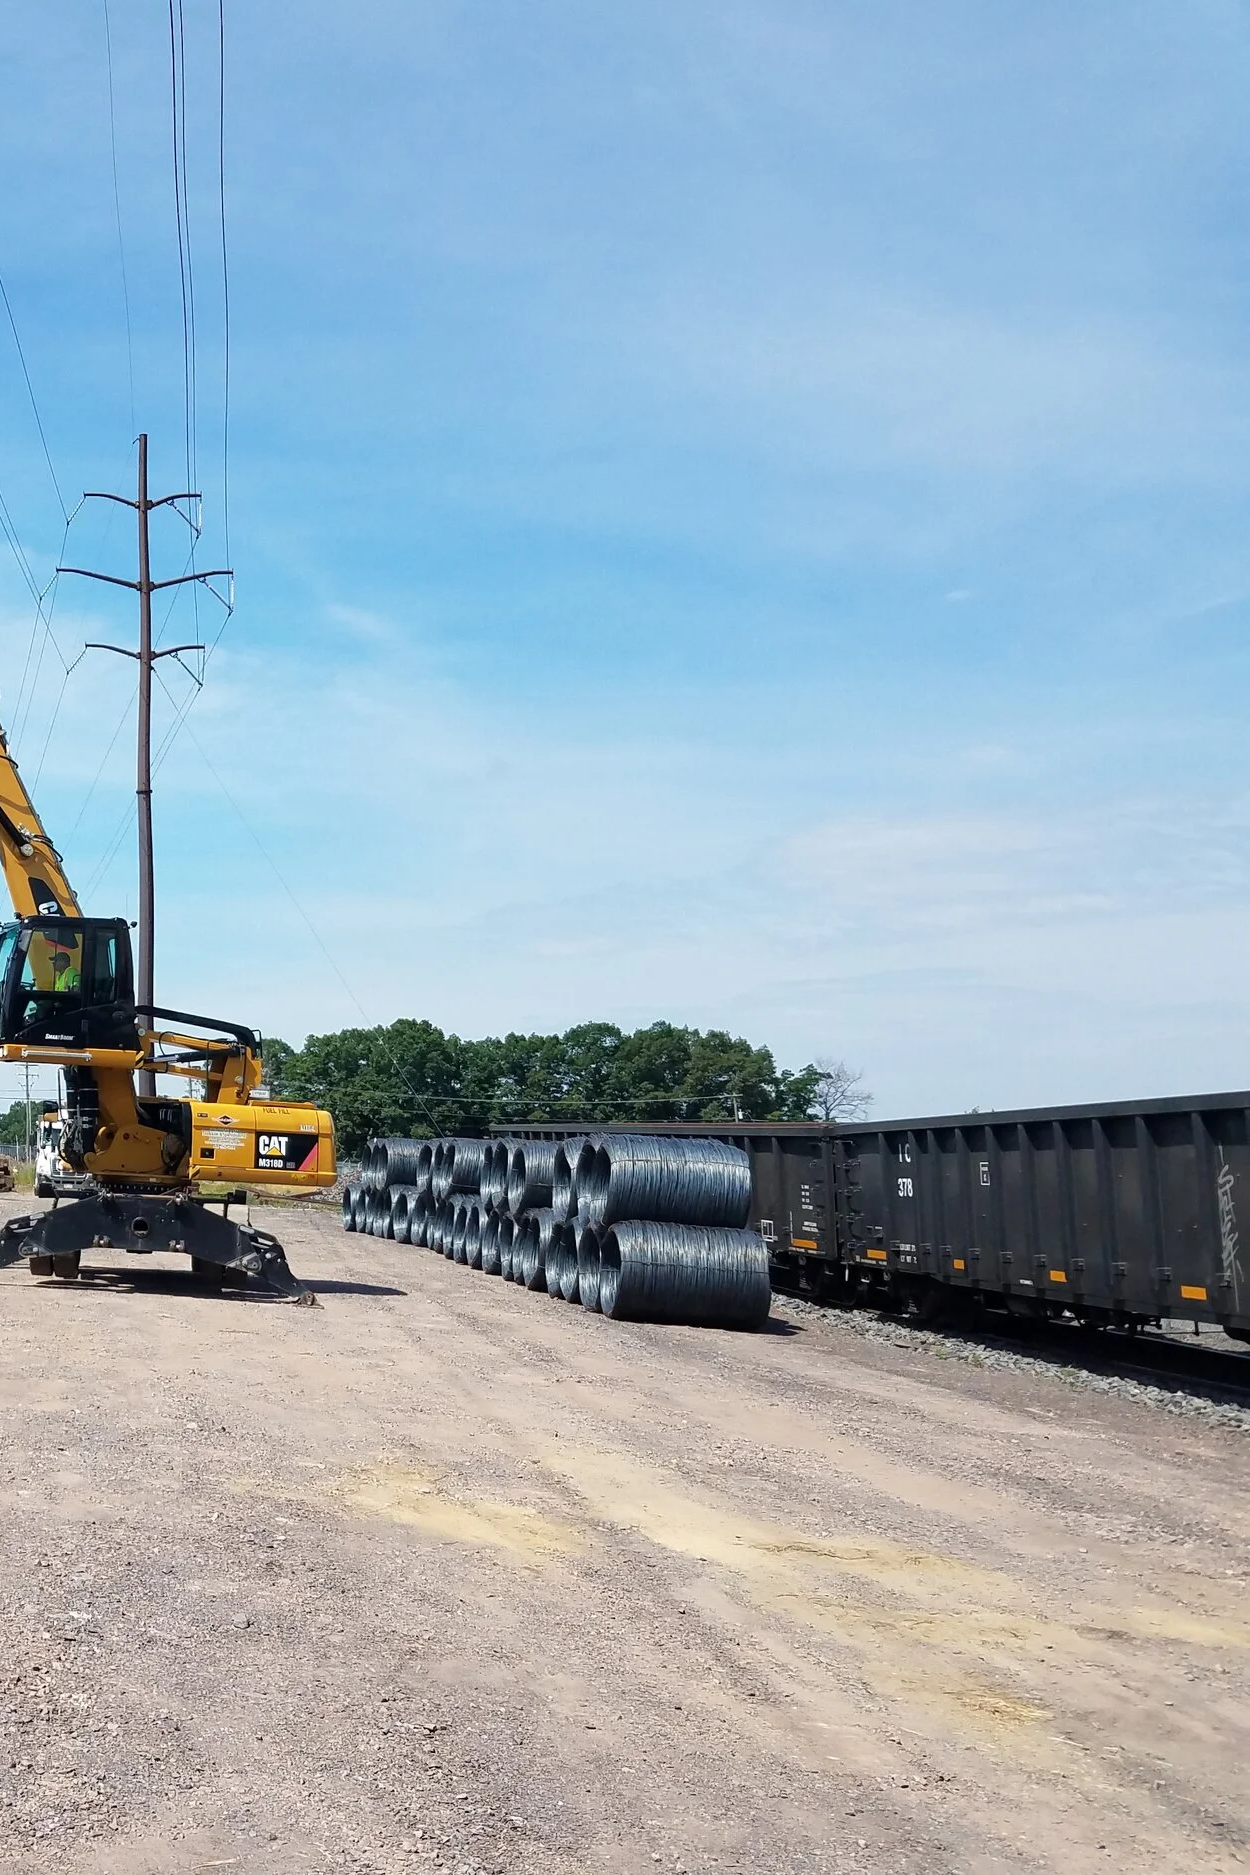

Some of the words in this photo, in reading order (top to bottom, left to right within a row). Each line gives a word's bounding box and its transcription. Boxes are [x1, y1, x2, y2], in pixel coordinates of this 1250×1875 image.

[259, 1135, 289, 1156] CAT
[258, 1158, 284, 1168] M318D
[897, 1177, 913, 1197] 378
